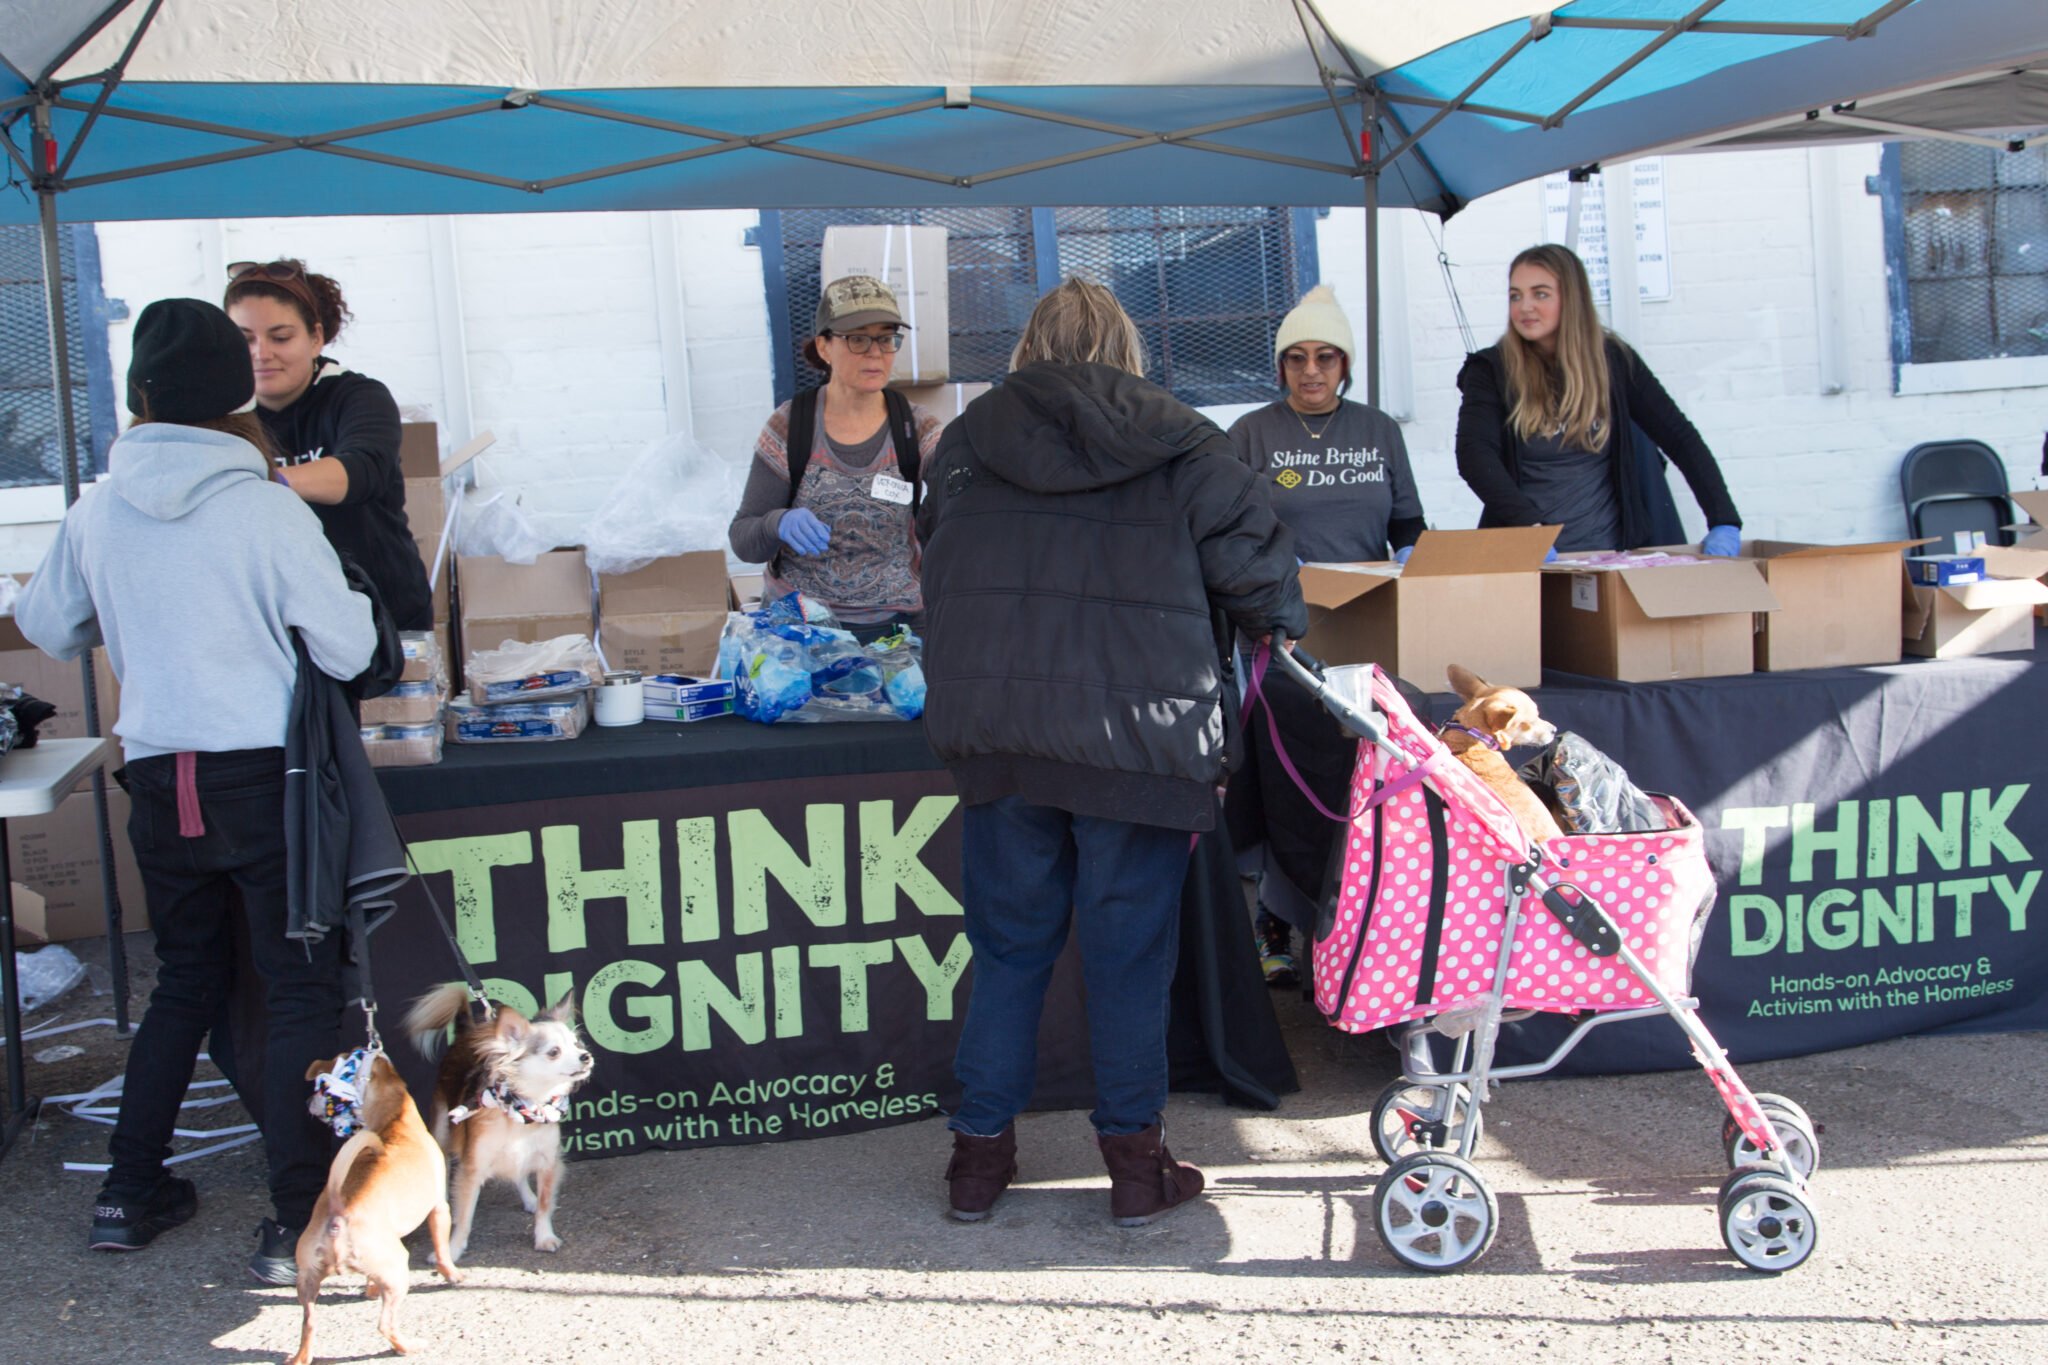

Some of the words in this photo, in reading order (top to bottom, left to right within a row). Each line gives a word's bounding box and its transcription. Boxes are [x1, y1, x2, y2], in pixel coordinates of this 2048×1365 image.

[1272, 450, 1320, 468] Shine
[1306, 470, 1336, 486] Do
[1340, 464, 1385, 485] Good
[1721, 784, 2034, 886] THINK
[407, 795, 966, 965] THINK
[1729, 870, 2044, 957] DIGNITY
[1747, 998, 1833, 1018] Activism
[1836, 991, 1882, 1012] with
[1886, 990, 1920, 1008] the
[1924, 979, 2014, 1004] Homeless
[1770, 972, 1870, 994] Hands-on
[1875, 962, 1972, 986] Advocacy
[1976, 957, 1992, 976] &
[560, 1090, 698, 1122] ands-on
[708, 1072, 867, 1108] Advocacy
[875, 1063, 895, 1088] &
[644, 1113, 719, 1141] with
[729, 1111, 783, 1136] the
[790, 1092, 939, 1130] Homeless
